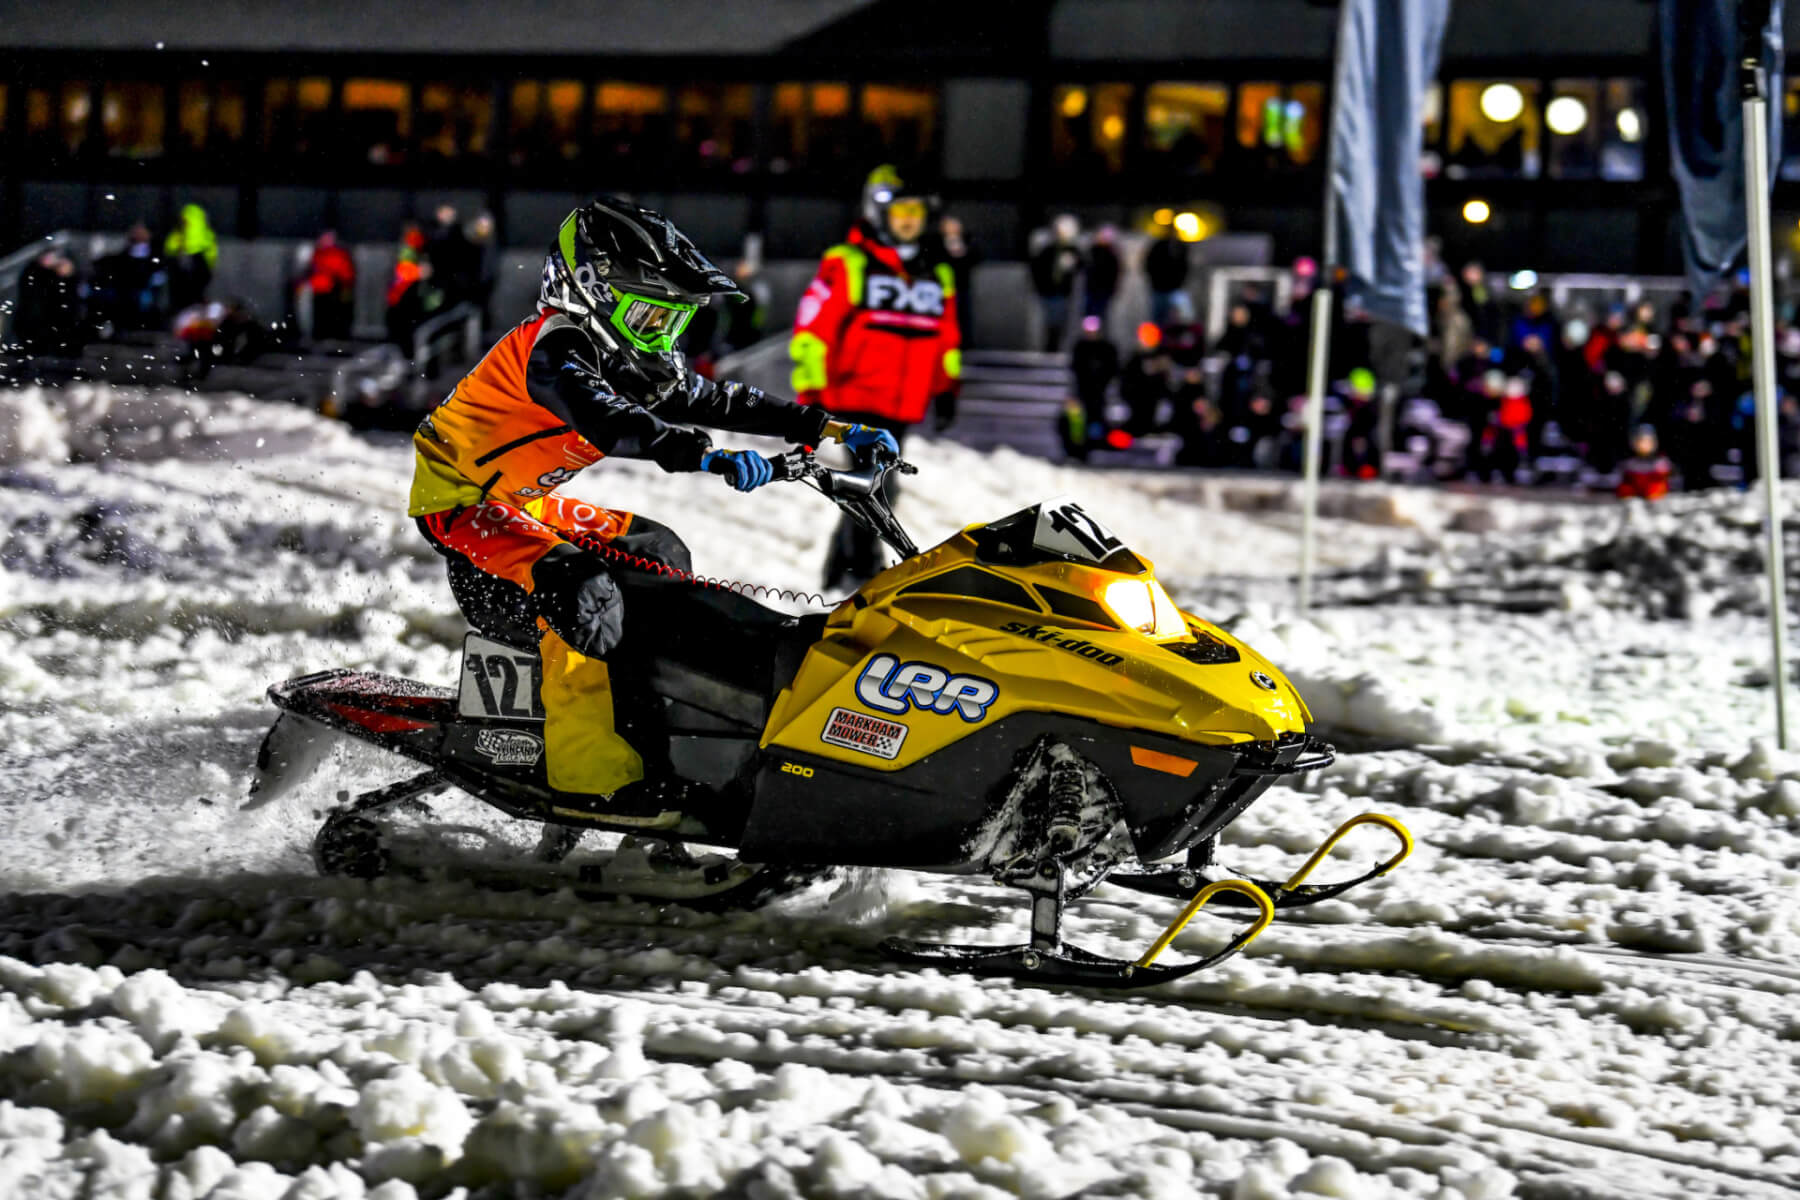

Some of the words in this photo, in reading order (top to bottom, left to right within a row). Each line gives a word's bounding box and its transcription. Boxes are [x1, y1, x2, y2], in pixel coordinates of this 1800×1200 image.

[867, 274, 944, 315] FXR
[1048, 503, 1123, 559] 12
[1000, 622, 1125, 666] ski-doo
[465, 654, 543, 717] 127
[855, 653, 999, 722] LRR
[827, 723, 879, 747] MOWER
[833, 710, 902, 739] MARKHAM
[781, 762, 814, 777] 200
